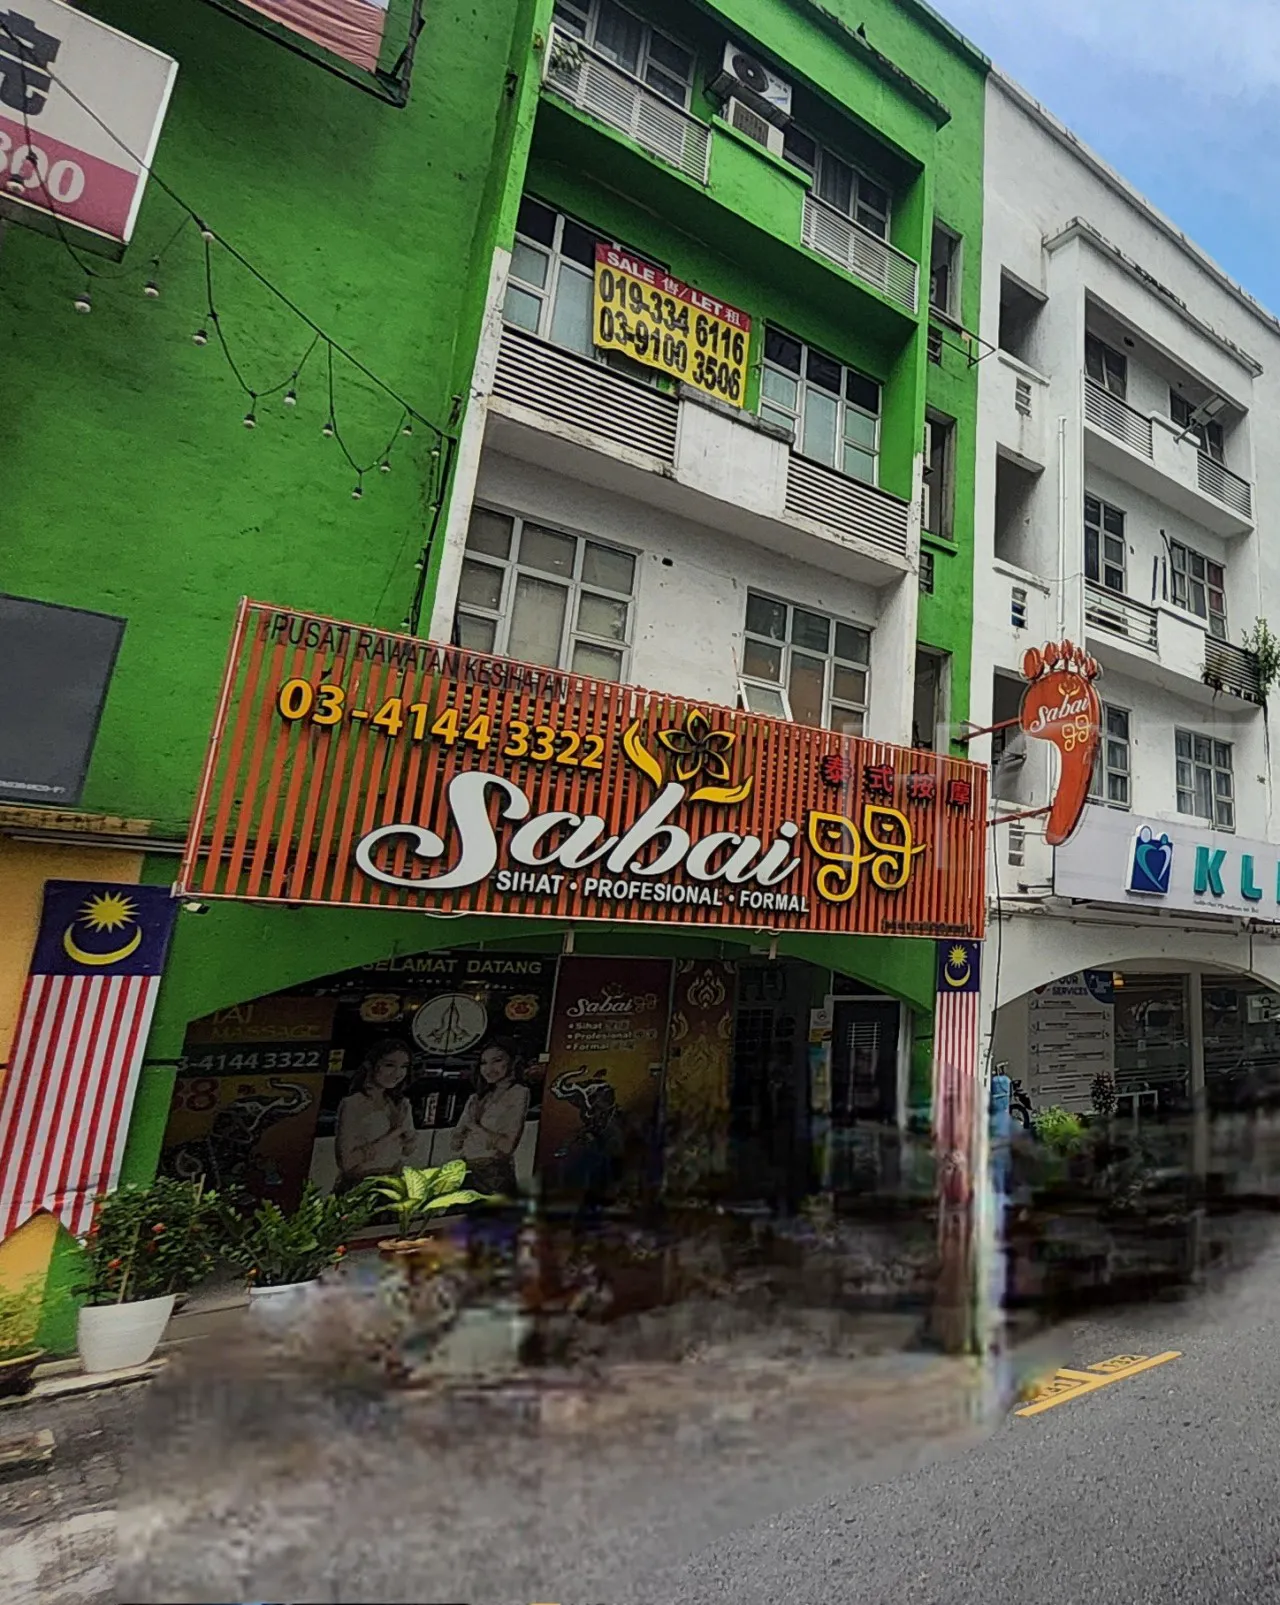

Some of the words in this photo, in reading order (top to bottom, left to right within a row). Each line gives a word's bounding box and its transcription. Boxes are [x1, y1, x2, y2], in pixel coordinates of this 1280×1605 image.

[606, 252, 656, 284] SALE
[691, 291, 723, 317] LET
[599, 268, 690, 338] 019-334
[695, 313, 745, 366] 6116
[600, 306, 688, 374] 03-9100
[692, 349, 742, 401] 3506
[270, 613, 349, 655] PUSAT
[356, 632, 458, 679] RAWATAN
[464, 655, 570, 702] KESIHATAN
[278, 678, 492, 752] 03-4144
[503, 720, 605, 770] 3322
[1031, 693, 1090, 732] Sabai
[355, 770, 801, 890] Sabai
[496, 872, 564, 895] SIHAT
[584, 878, 723, 907] PROFESIONAL
[739, 892, 810, 913] FORMAL
[467, 959, 543, 974] DATANG
[212, 1024, 321, 1039] MASSAGE
[566, 995, 634, 1017] Sabai
[261, 1050, 320, 1069] 3322
